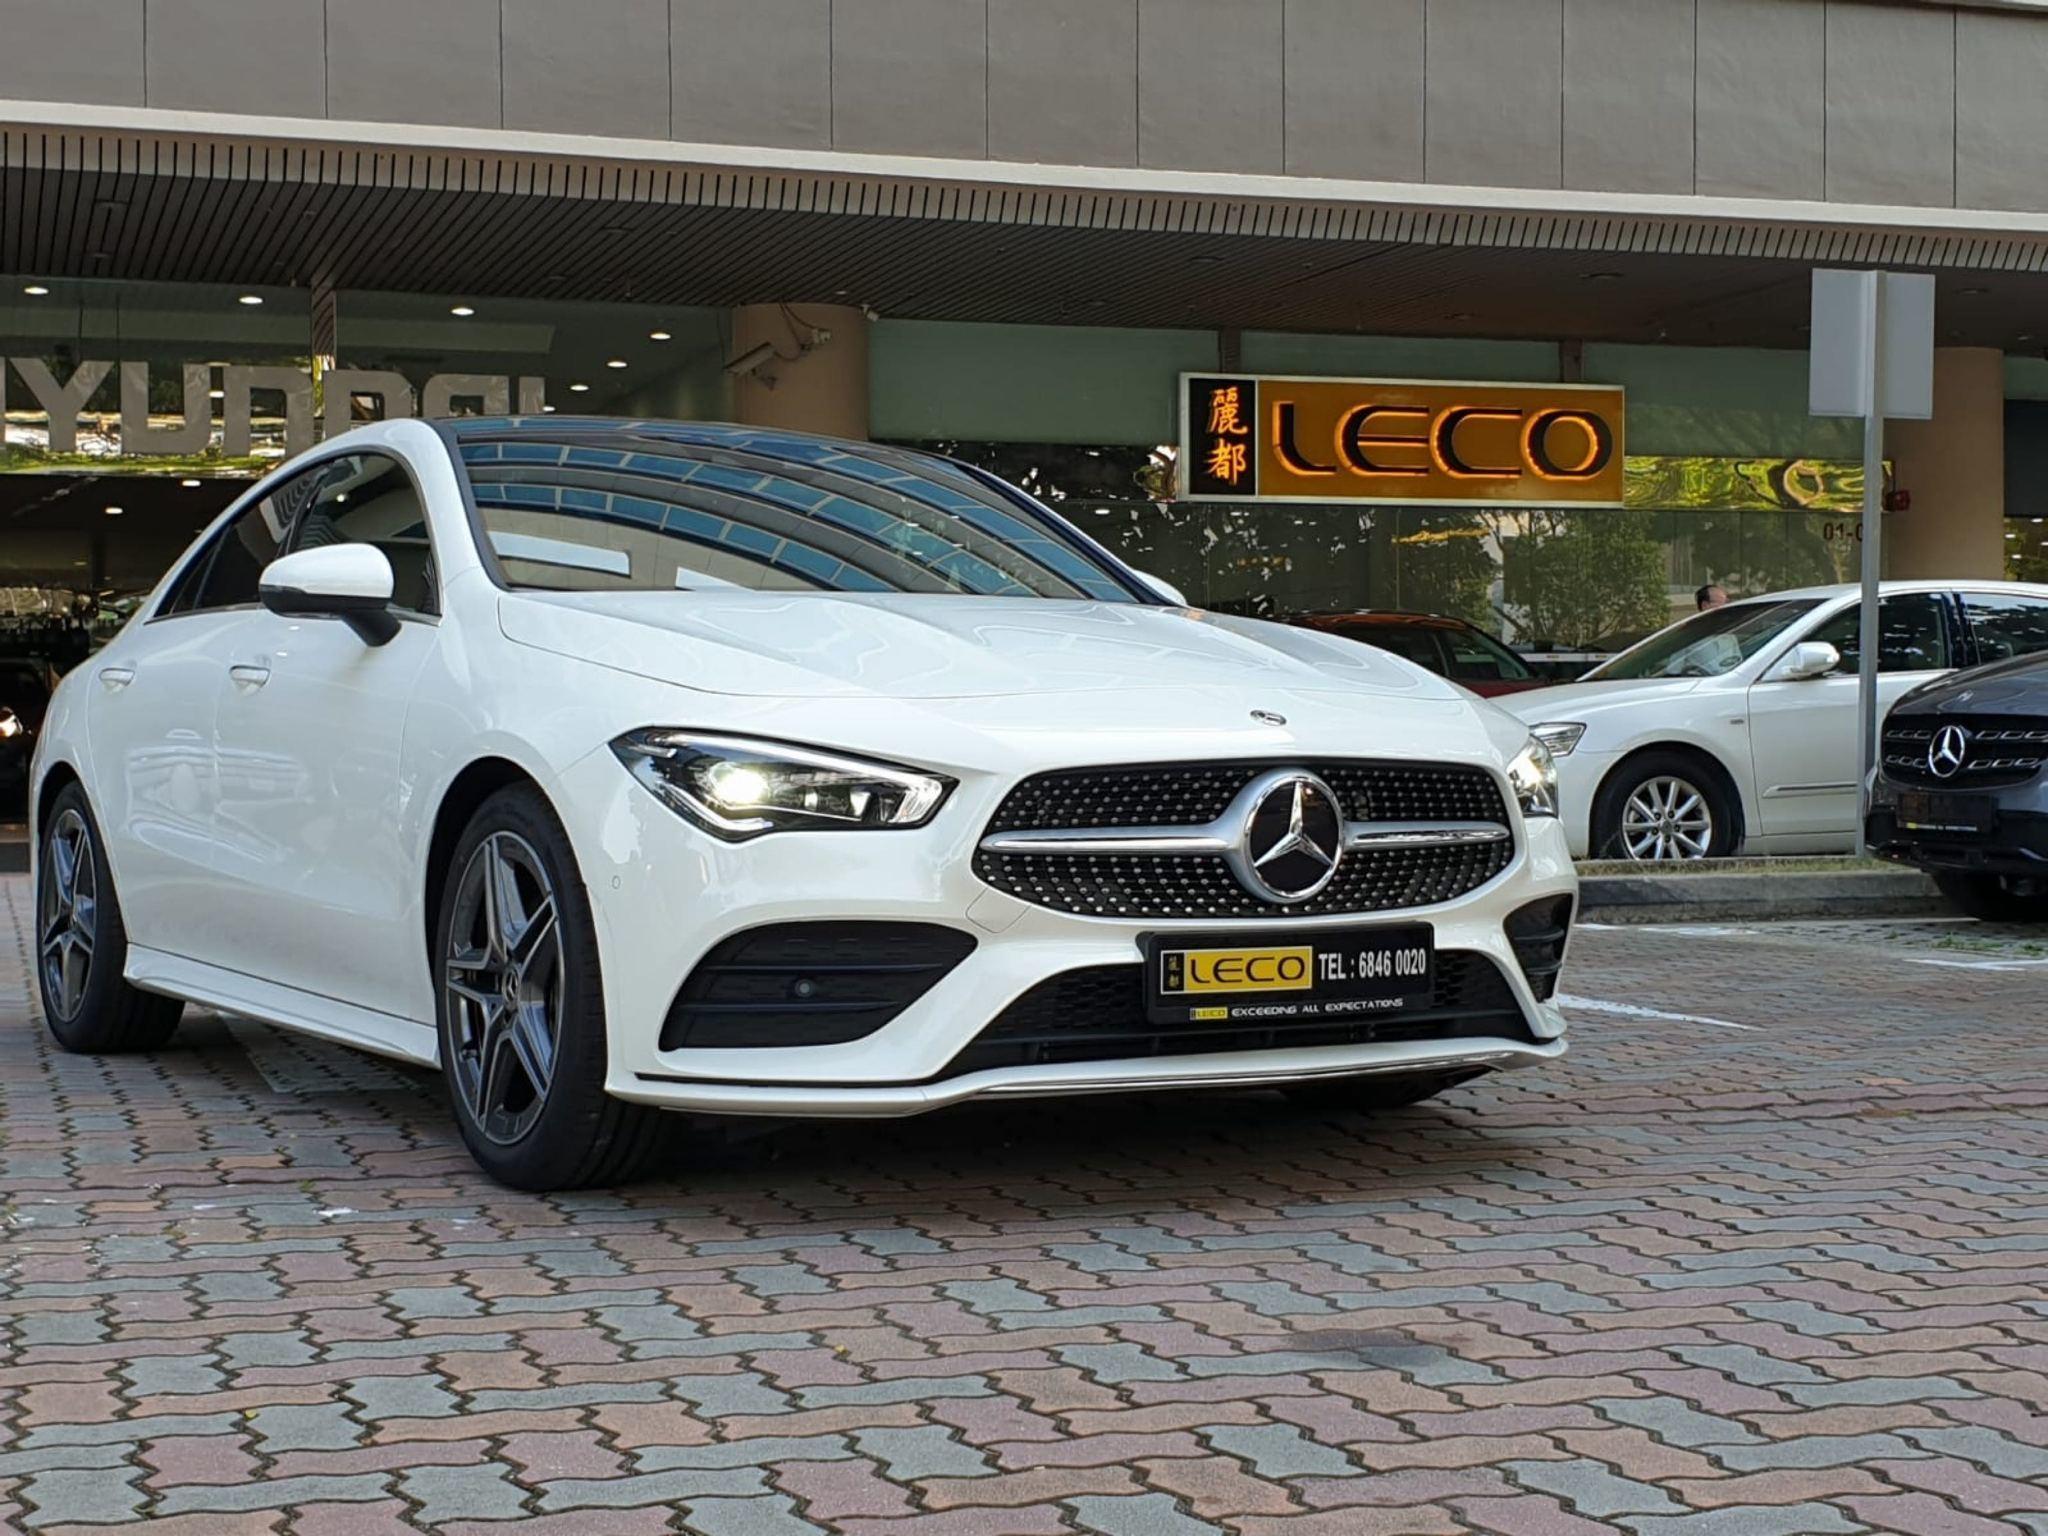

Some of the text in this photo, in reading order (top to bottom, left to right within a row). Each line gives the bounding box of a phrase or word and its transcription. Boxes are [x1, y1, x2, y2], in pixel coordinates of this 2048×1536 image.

[0, 357, 546, 456] YUND
[1207, 386, 1249, 486] 麗都
[1272, 401, 1613, 481] LECO
[1190, 956, 1305, 984] LECO
[1358, 949, 1392, 979] 6846
[1395, 948, 1427, 976] 0020
[1231, 1005, 1297, 1017] EXCEEDING
[1302, 1004, 1319, 1013] ALL
[1324, 998, 1404, 1012] EXPECTATIONS
